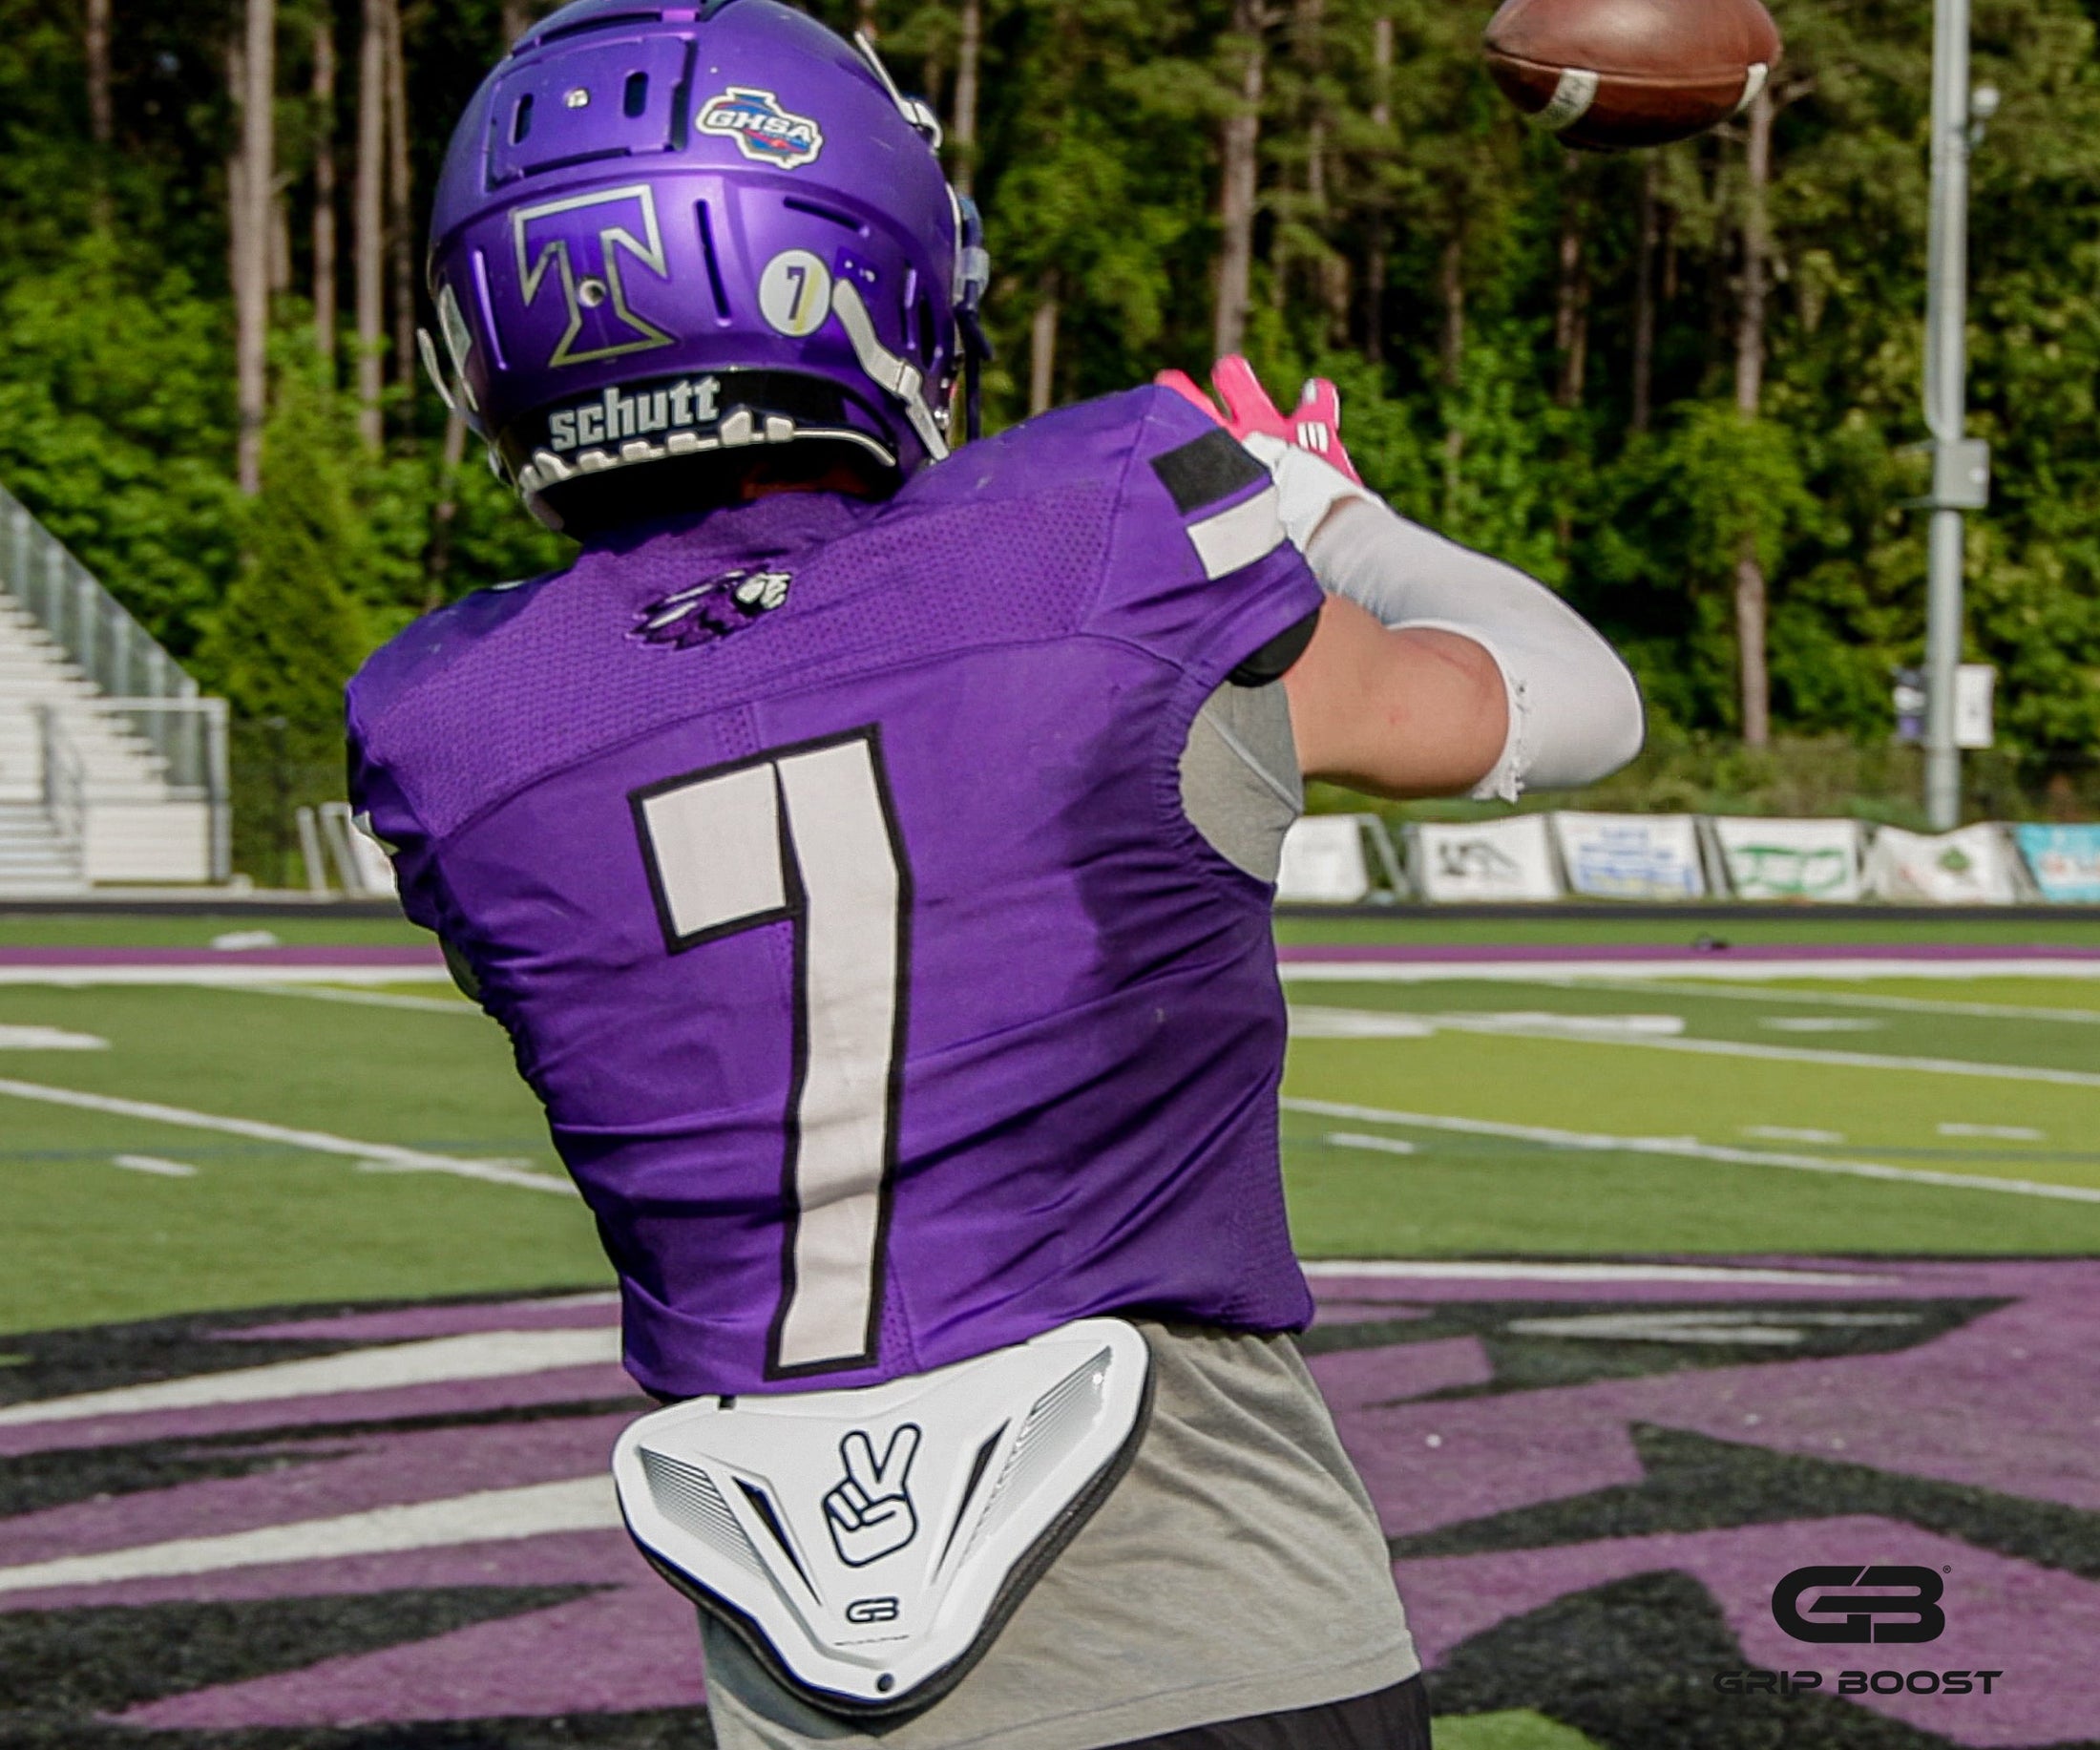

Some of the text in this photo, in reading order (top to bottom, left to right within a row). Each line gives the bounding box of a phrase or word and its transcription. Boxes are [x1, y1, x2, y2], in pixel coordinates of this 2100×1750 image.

[706, 109, 810, 144] GHSA
[786, 264, 813, 323] 7
[549, 376, 720, 451] schutt
[628, 723, 913, 1381] 7
